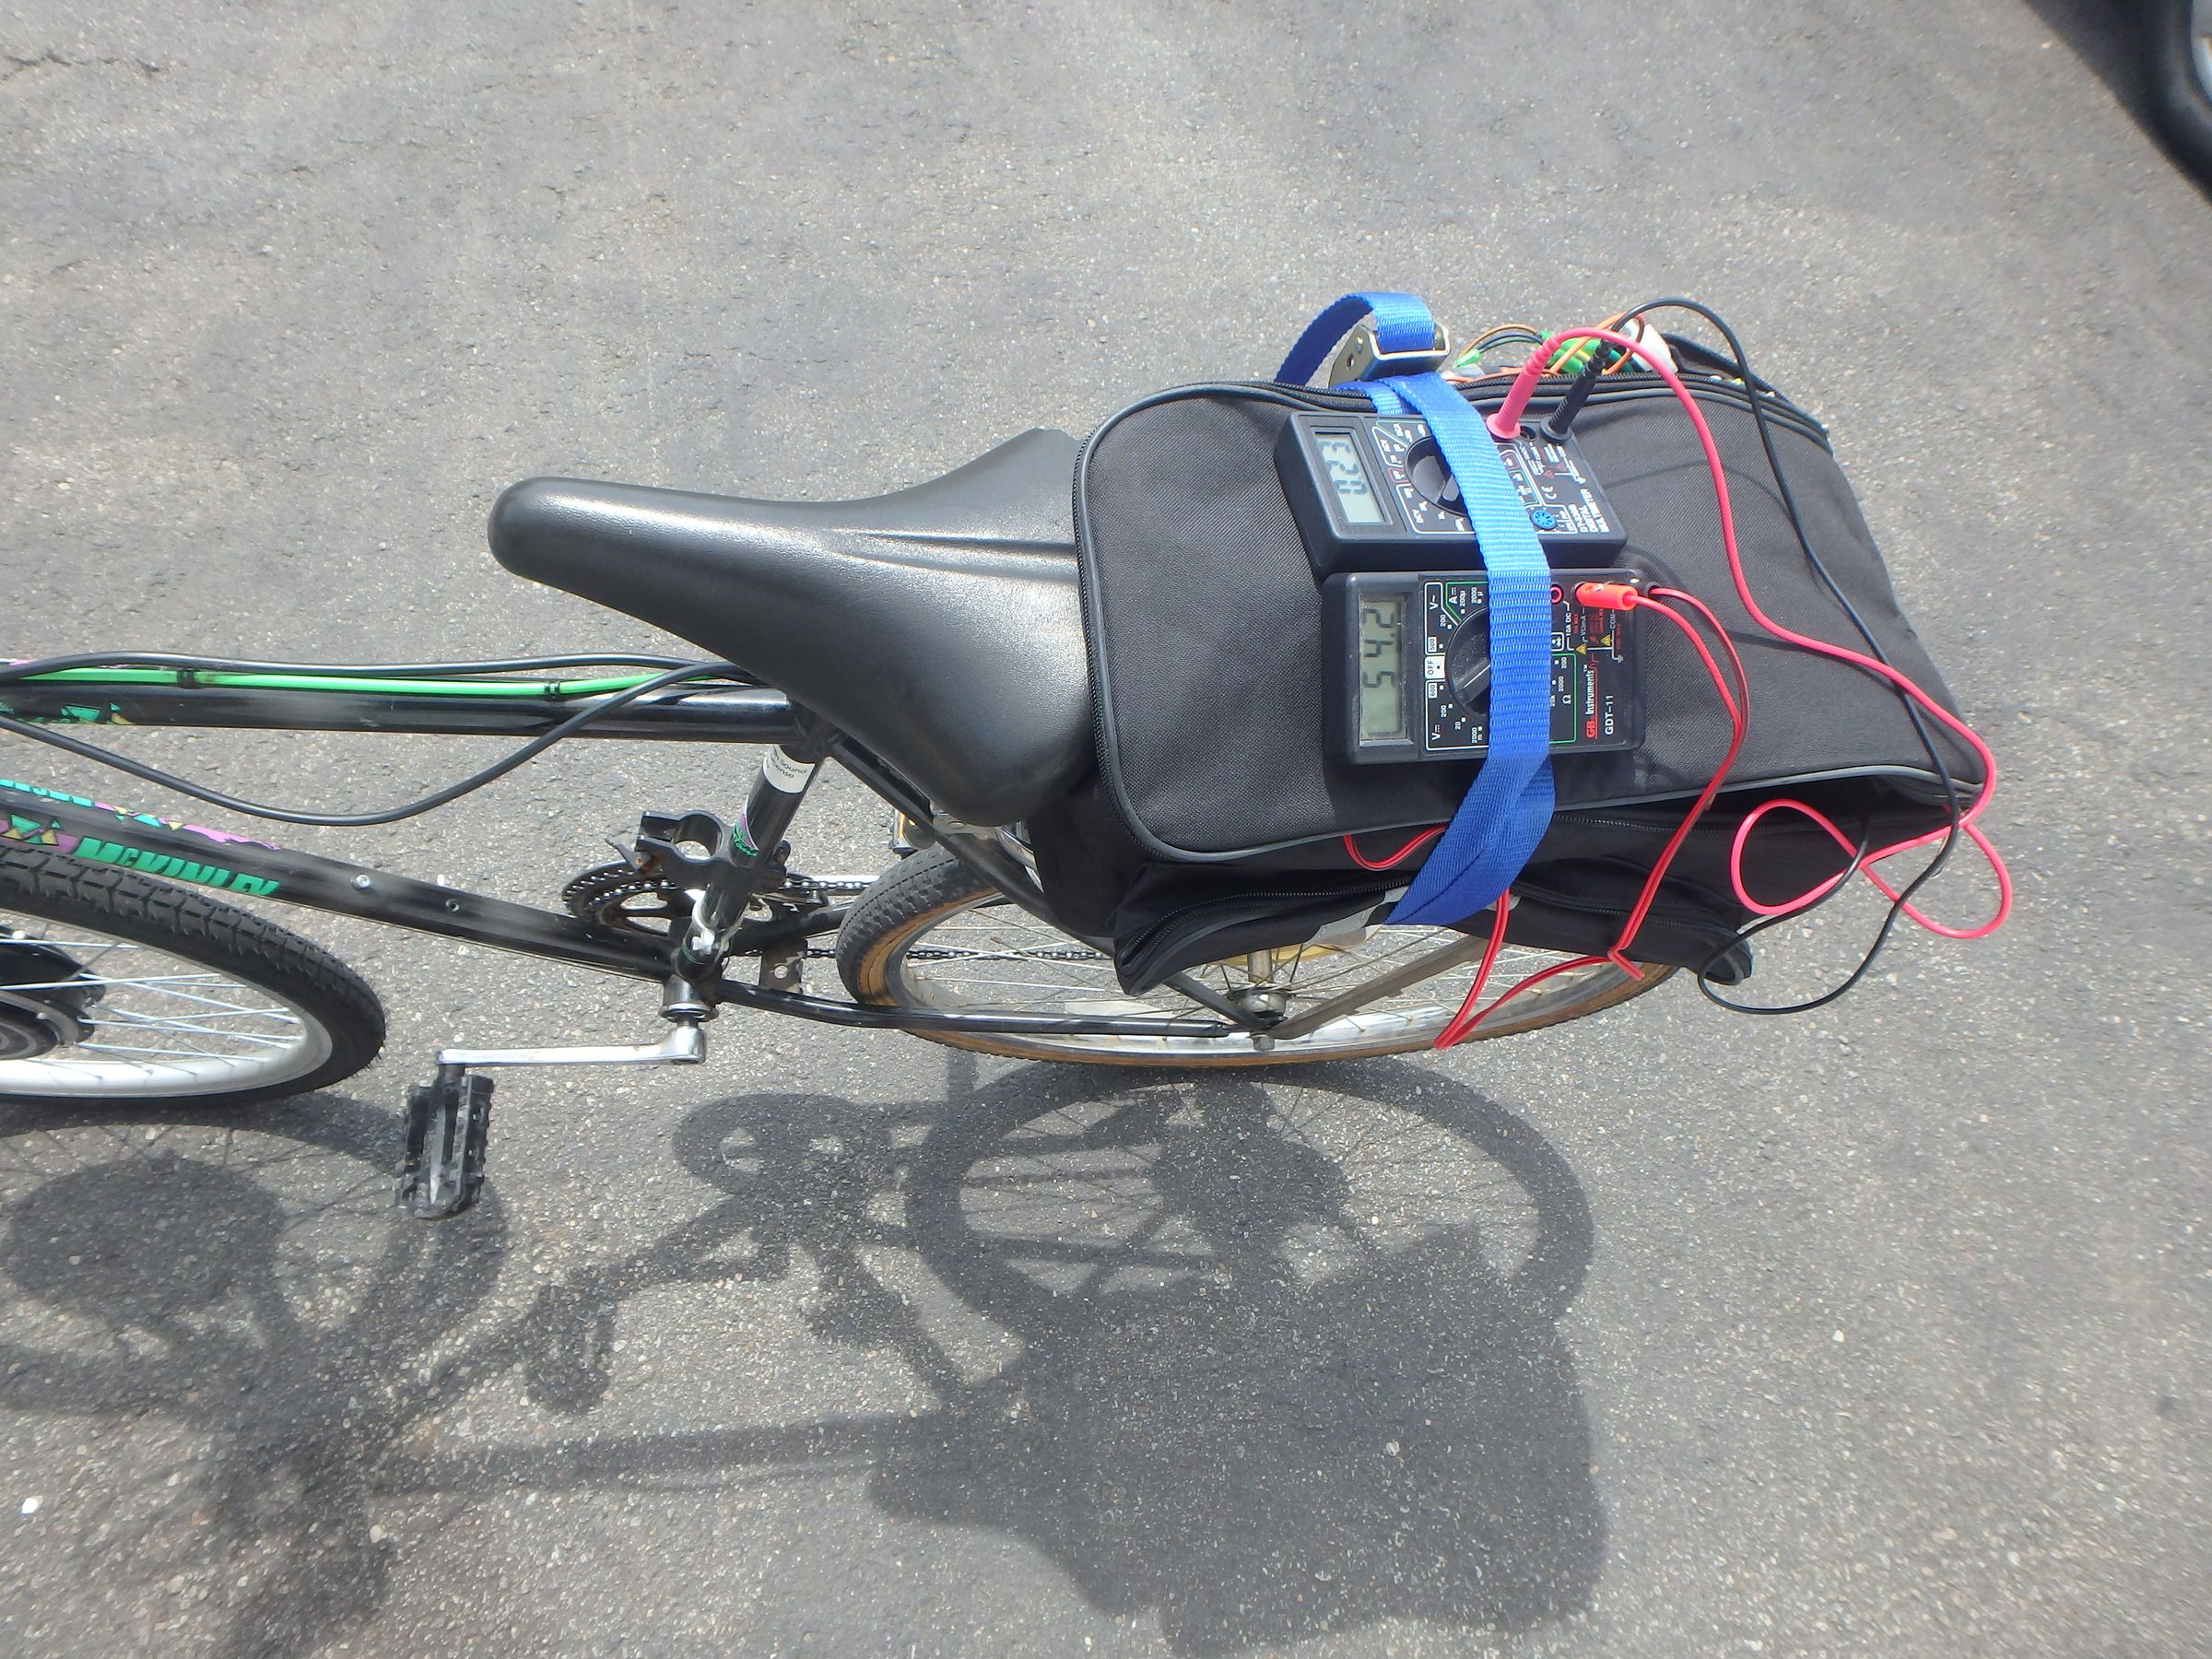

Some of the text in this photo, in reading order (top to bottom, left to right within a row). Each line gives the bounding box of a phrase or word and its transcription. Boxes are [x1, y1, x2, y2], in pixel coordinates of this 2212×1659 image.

[1565, 612, 1571, 623] DC
[1363, 608, 1395, 688] 54.2
[1606, 695, 1614, 735] GDT-11
[1455, 722, 1461, 730] 20
[780, 759, 807, 774] Sound
